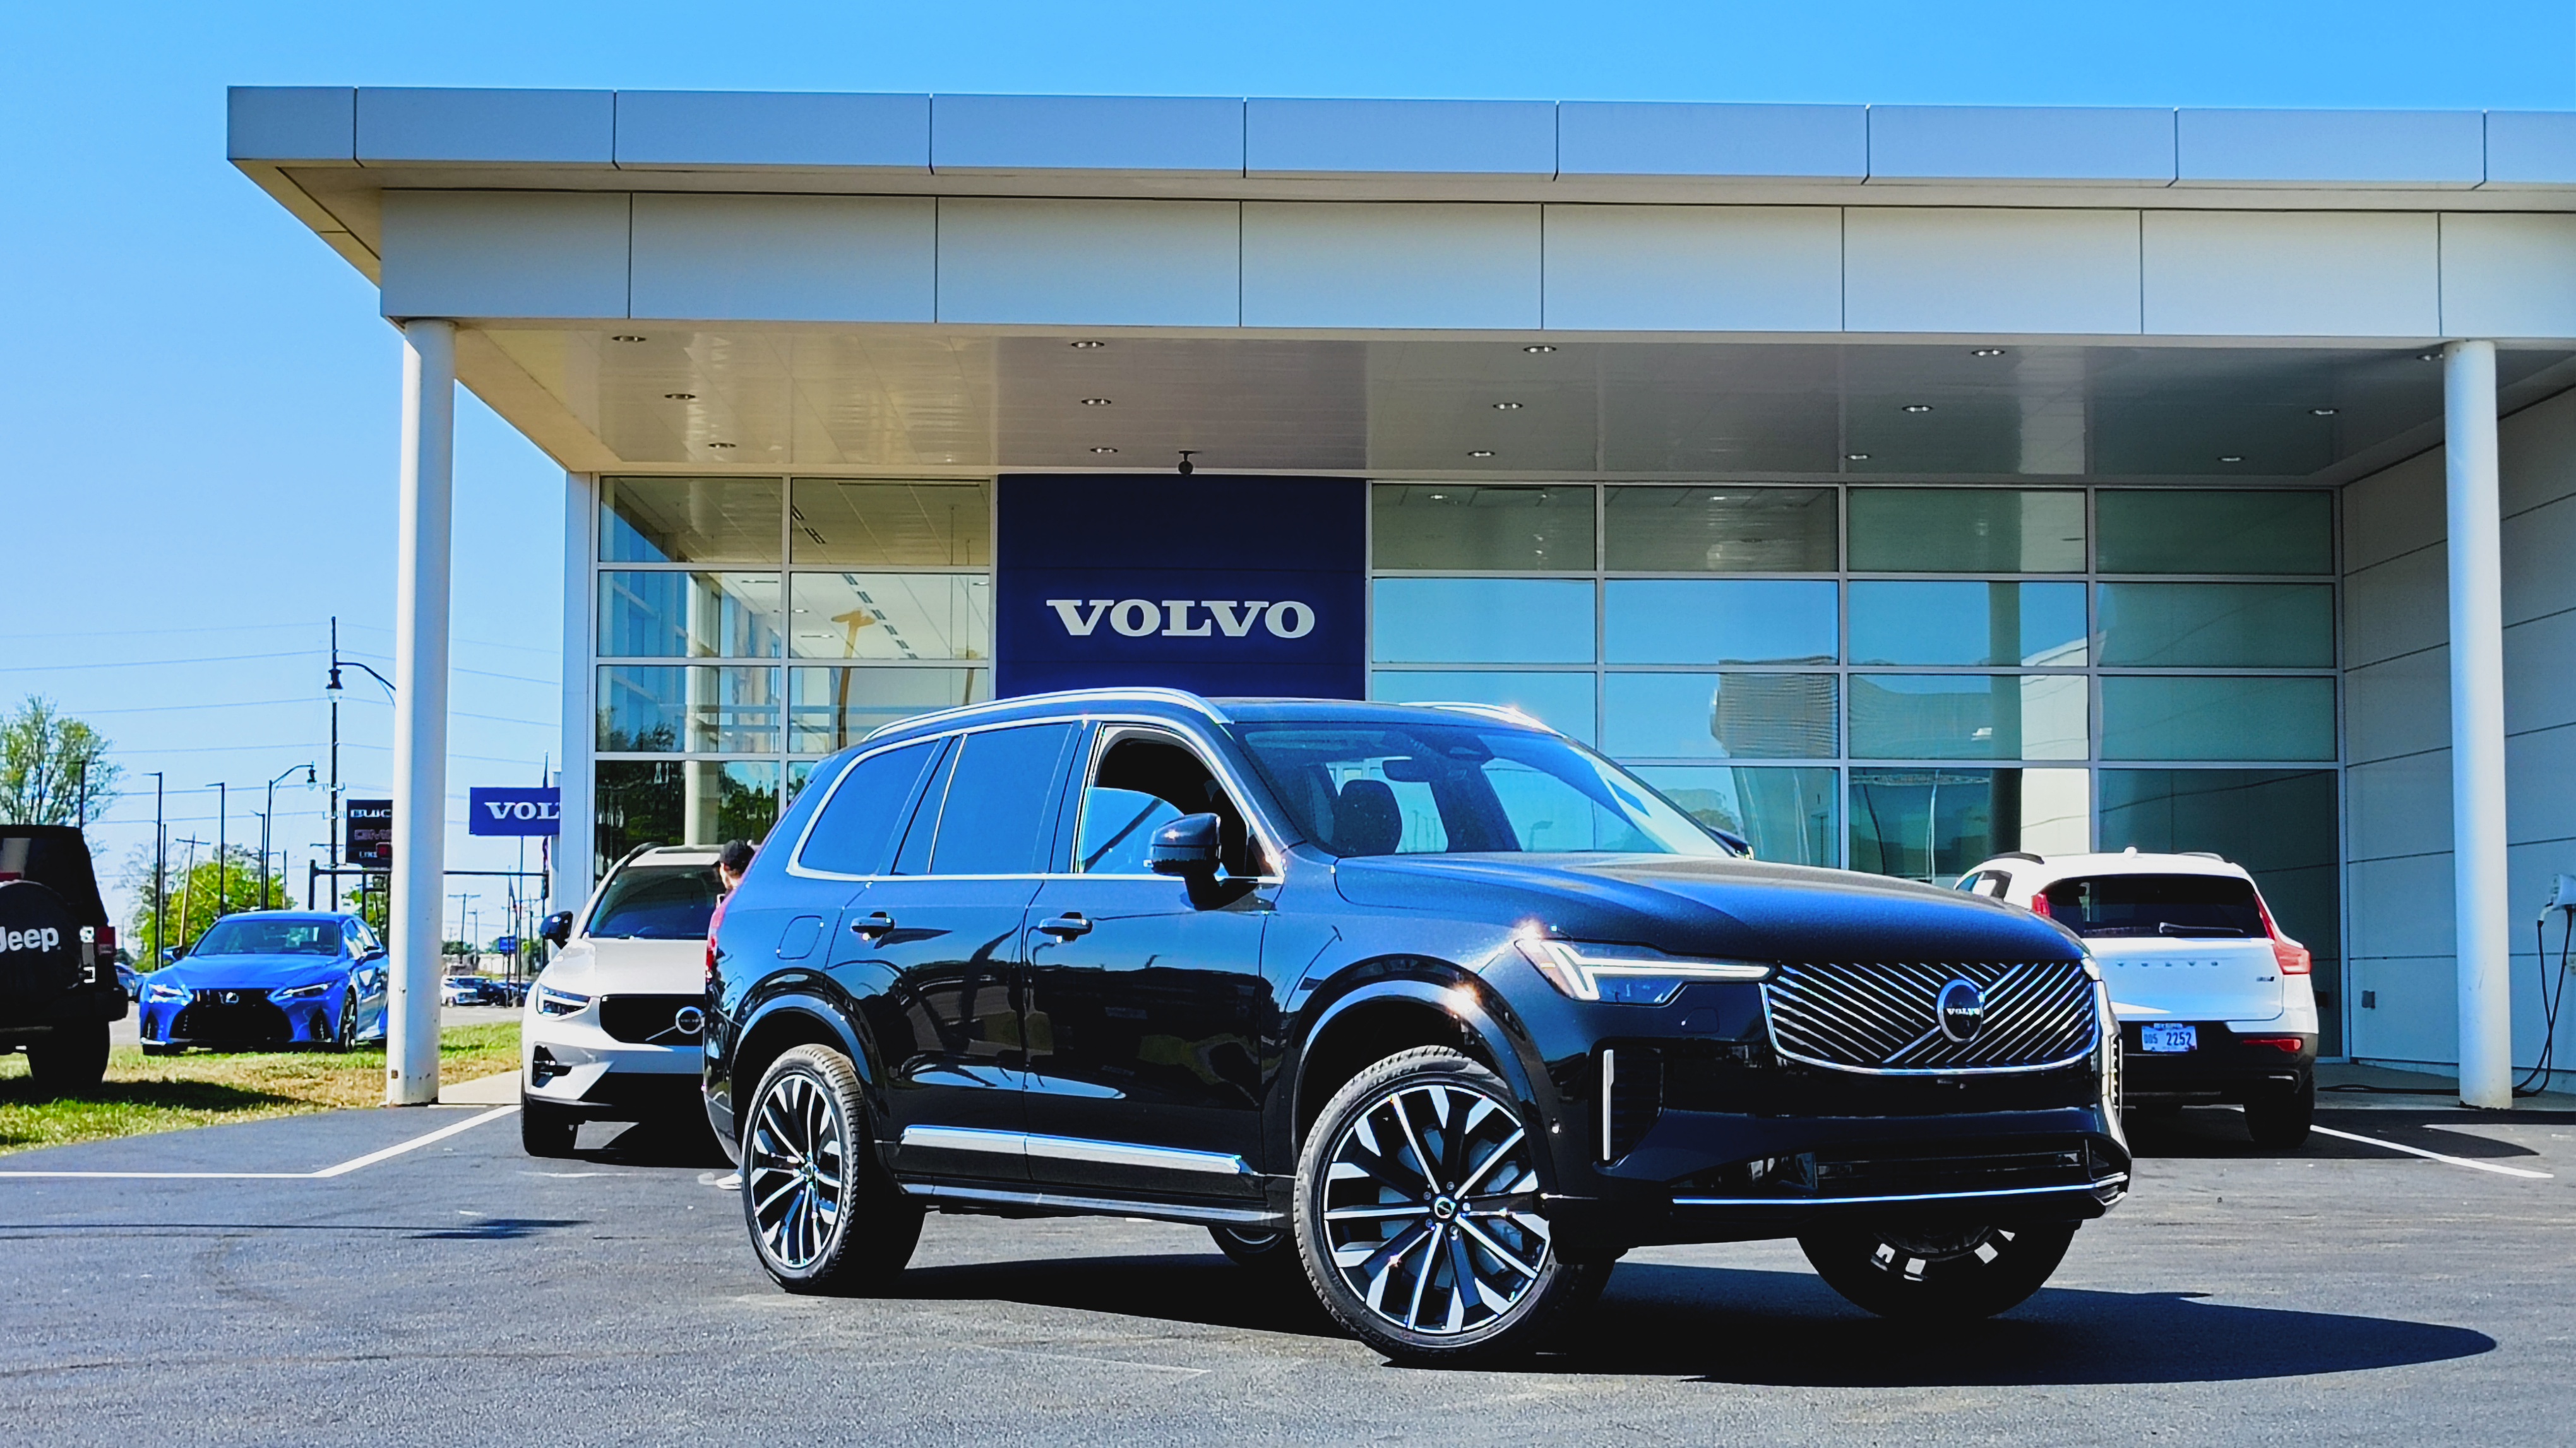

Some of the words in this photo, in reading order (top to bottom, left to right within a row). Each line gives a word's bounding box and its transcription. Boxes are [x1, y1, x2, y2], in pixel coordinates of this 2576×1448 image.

[1046, 598, 1315, 639] VOLVO
[484, 802, 559, 819] VOL
[2167, 1032, 2191, 1045] 2252
